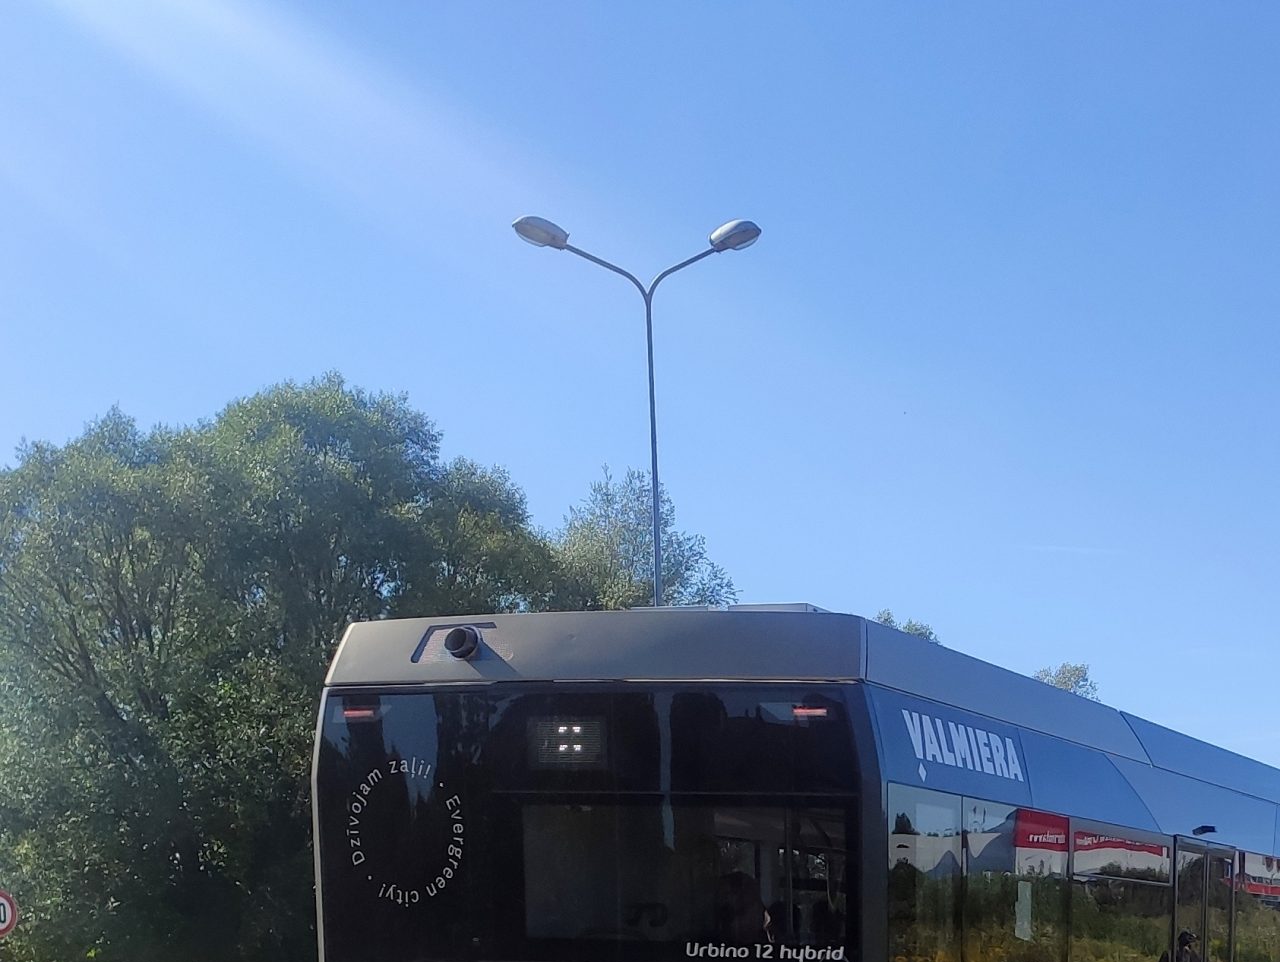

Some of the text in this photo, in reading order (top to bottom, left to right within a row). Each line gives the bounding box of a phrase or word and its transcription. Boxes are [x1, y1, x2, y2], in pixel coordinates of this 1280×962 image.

[902, 709, 1024, 782] VALMIERA
[346, 757, 431, 866] Dzīvojam zaļi!
[378, 794, 465, 908] Evergreen city!
[686, 942, 750, 958] Urbino
[754, 943, 773, 959] 12
